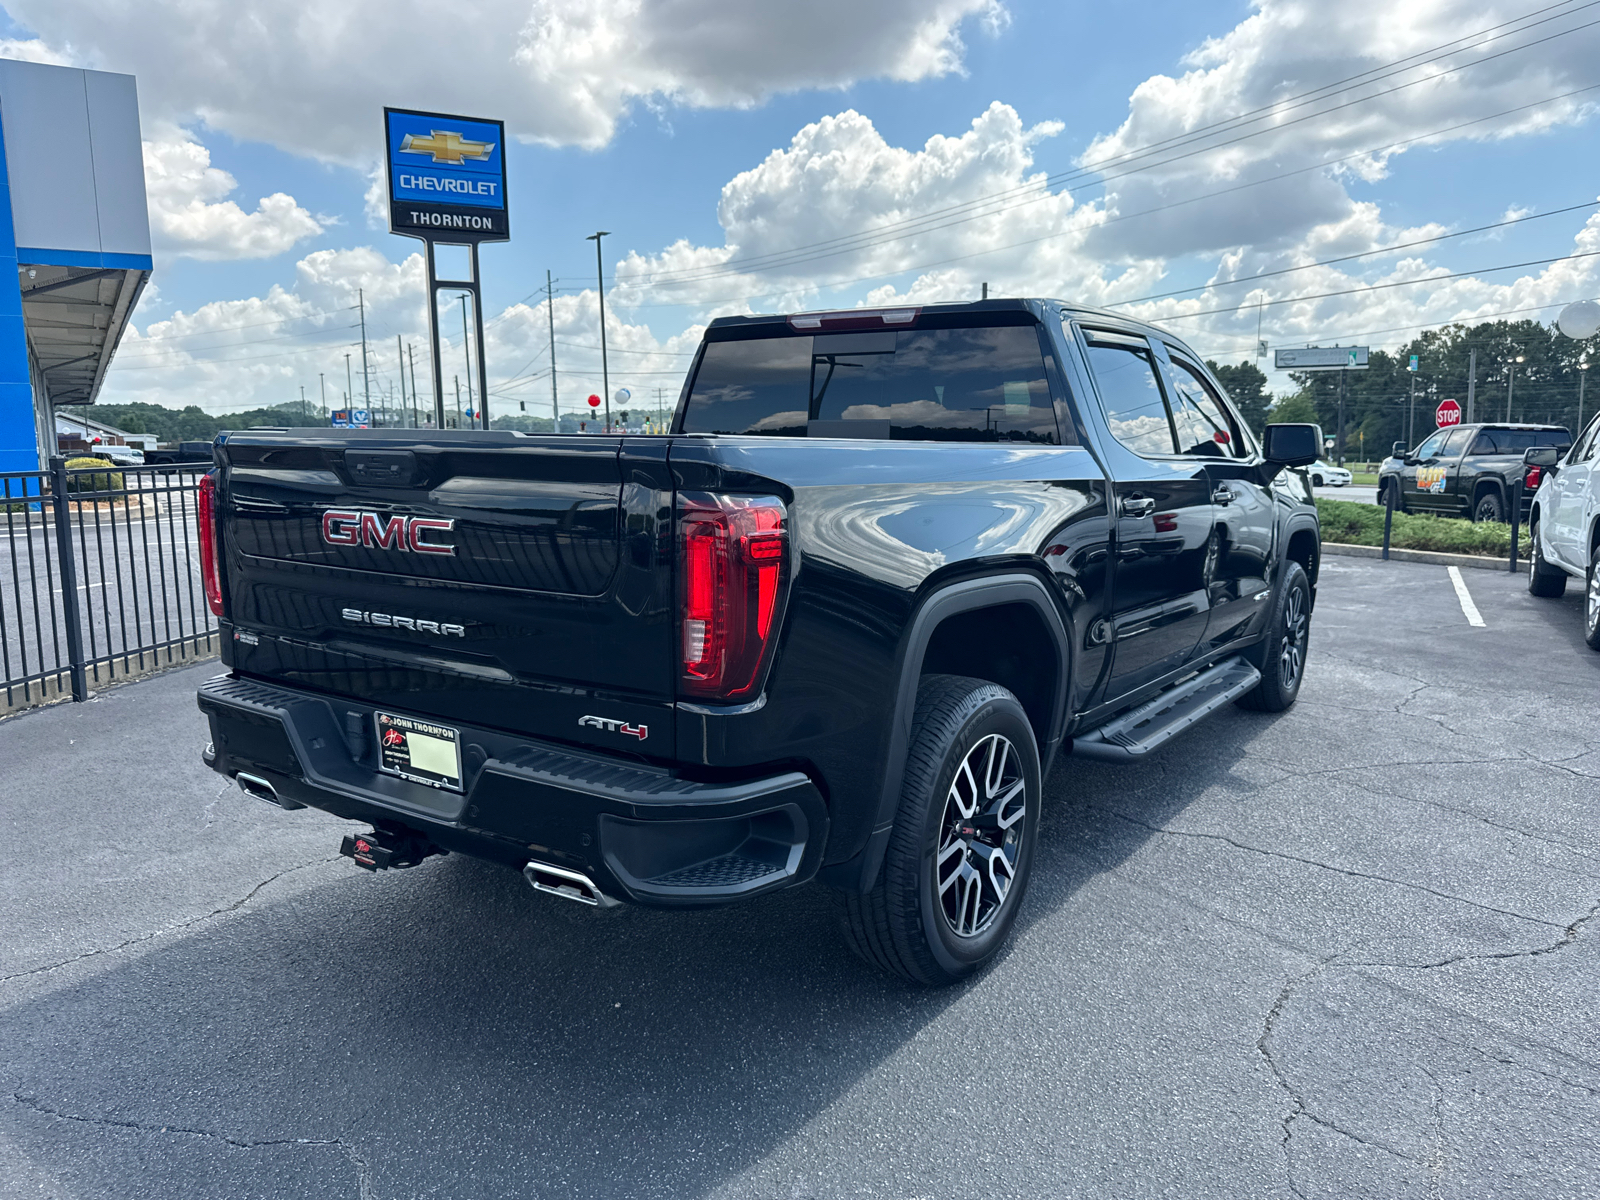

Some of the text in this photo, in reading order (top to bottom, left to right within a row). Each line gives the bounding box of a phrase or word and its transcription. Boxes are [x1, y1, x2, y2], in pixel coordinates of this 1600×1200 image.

[400, 174, 497, 196] CHEVROLET
[410, 211, 492, 229] THORNTON
[1437, 409, 1459, 423] STOP
[322, 509, 457, 557] GMC
[342, 608, 465, 637] SIERRA
[393, 718, 454, 738] JOHN THORNTON
[578, 715, 648, 741] AT4
[408, 776, 433, 786] CHEVROLET
